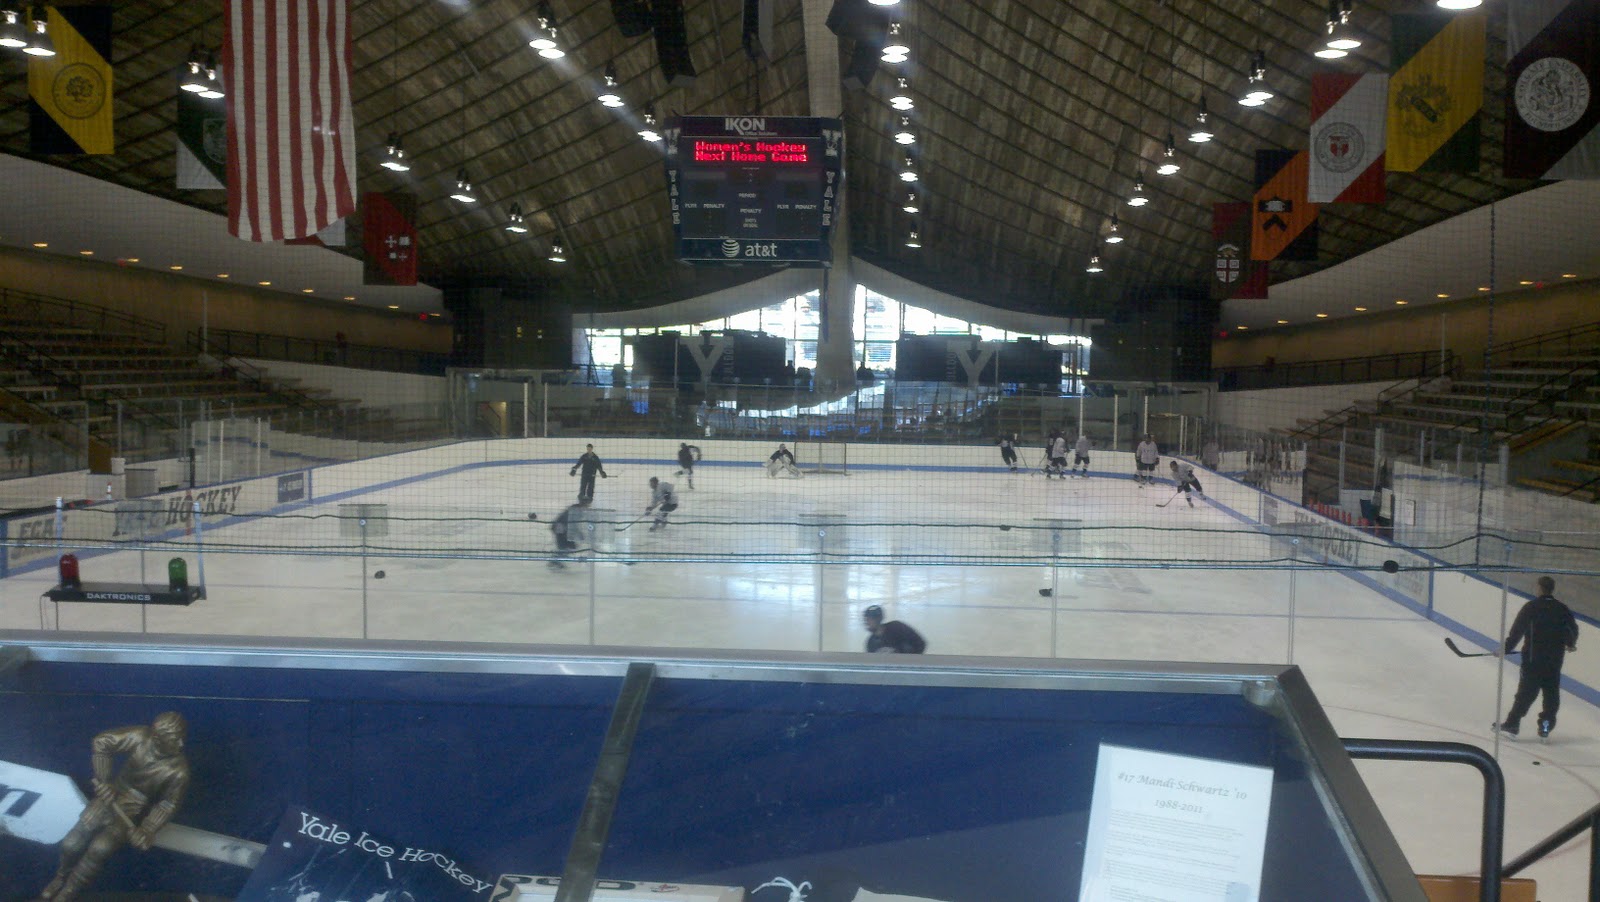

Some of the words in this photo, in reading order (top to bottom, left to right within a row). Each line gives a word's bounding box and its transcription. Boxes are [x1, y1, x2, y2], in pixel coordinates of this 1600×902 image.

[725, 117, 765, 135] IKON
[695, 141, 751, 152] Women's
[756, 142, 807, 153] Hockey
[695, 151, 726, 161] Next
[731, 151, 766, 162] Home
[771, 151, 808, 163] Game
[668, 169, 681, 225] YALE
[821, 171, 836, 226] YALE
[744, 242, 778, 258] at&t
[165, 485, 242, 526] HOCKEY
[86, 592, 152, 601] DAKTRONICS
[1117, 772, 1135, 784] #17
[1136, 774, 1175, 789] Mandi
[1176, 780, 1229, 797] Schwartz
[1154, 798, 1204, 814] 1988-2011
[298, 811, 351, 845] Yale
[354, 831, 395, 858] Ice
